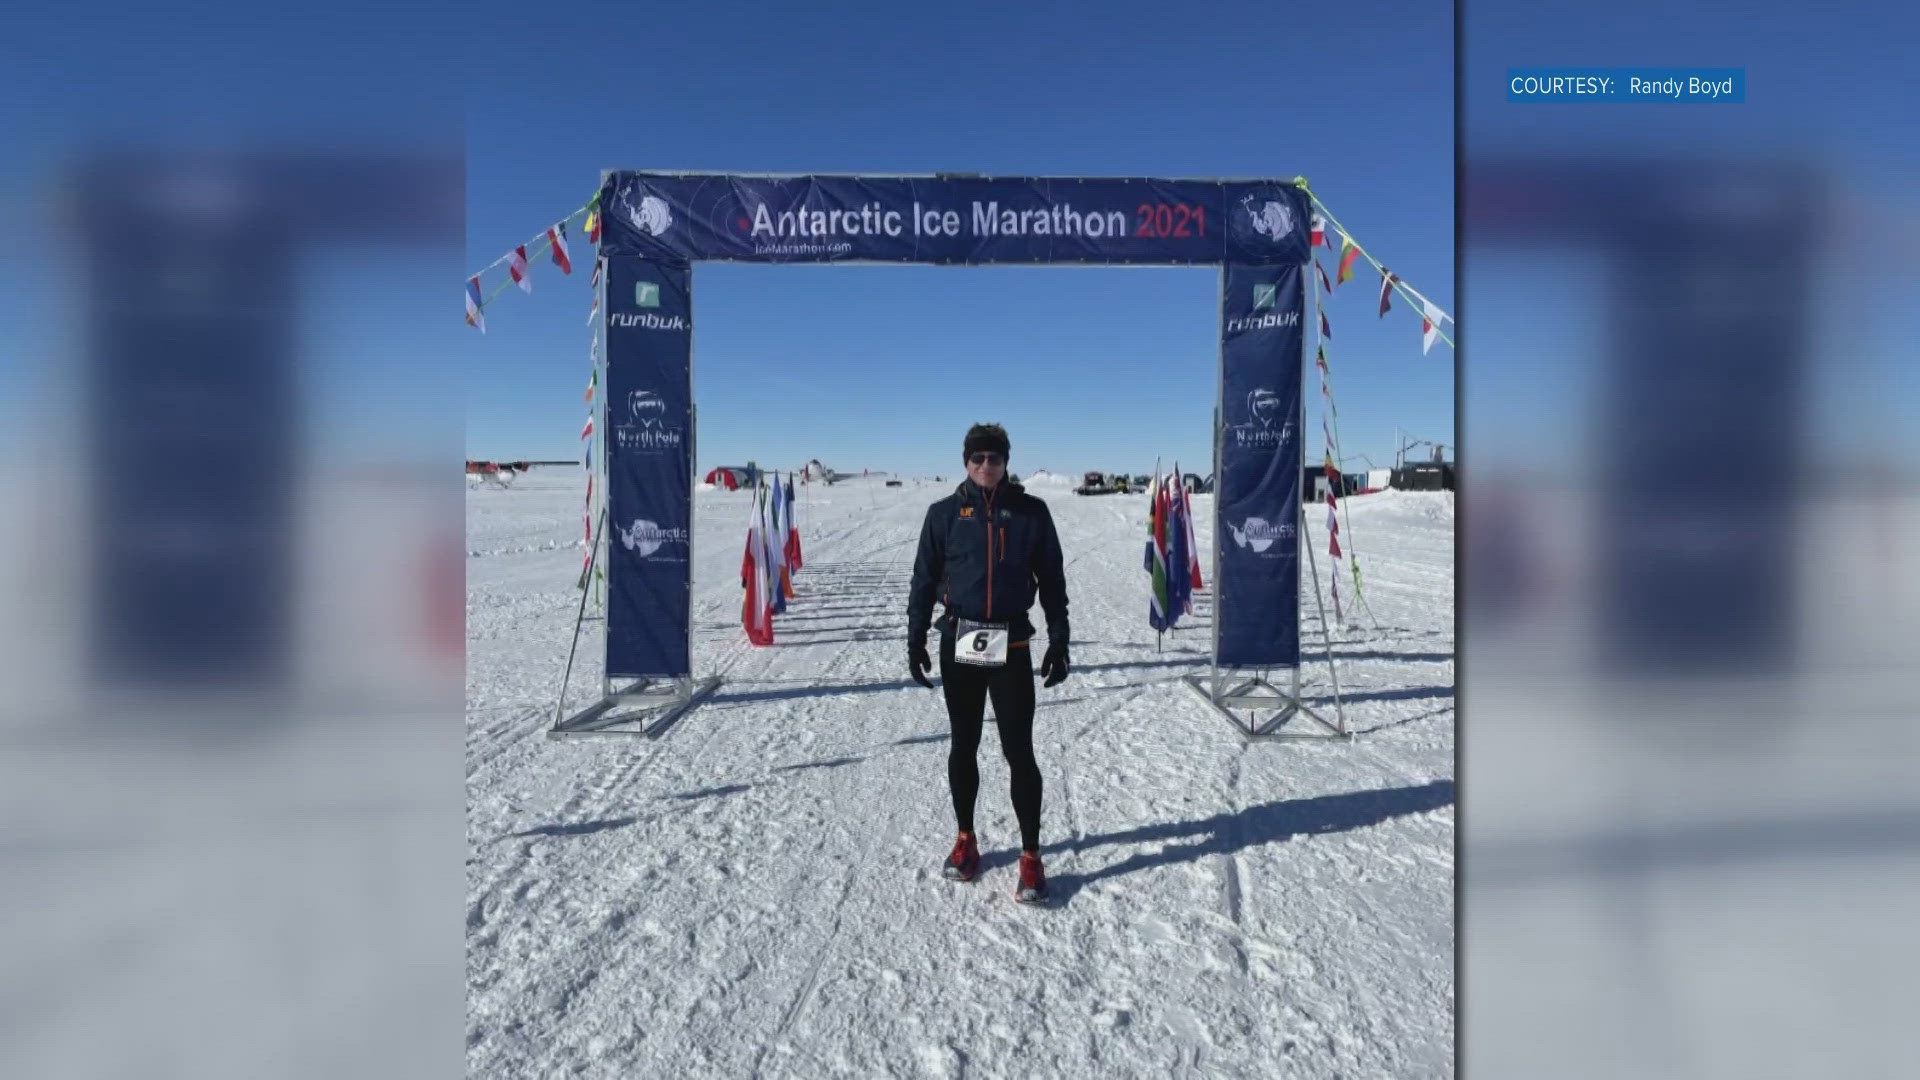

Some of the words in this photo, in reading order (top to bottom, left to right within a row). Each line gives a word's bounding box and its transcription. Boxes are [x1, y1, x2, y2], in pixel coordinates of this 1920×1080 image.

[751, 201, 902, 237] Antarctic
[914, 201, 960, 237] Ice
[971, 201, 1126, 237] Marathon
[1137, 204, 1206, 238] 2021
[610, 313, 684, 331] runbuk
[1228, 311, 1300, 332] runbuk
[972, 631, 989, 652] 6
